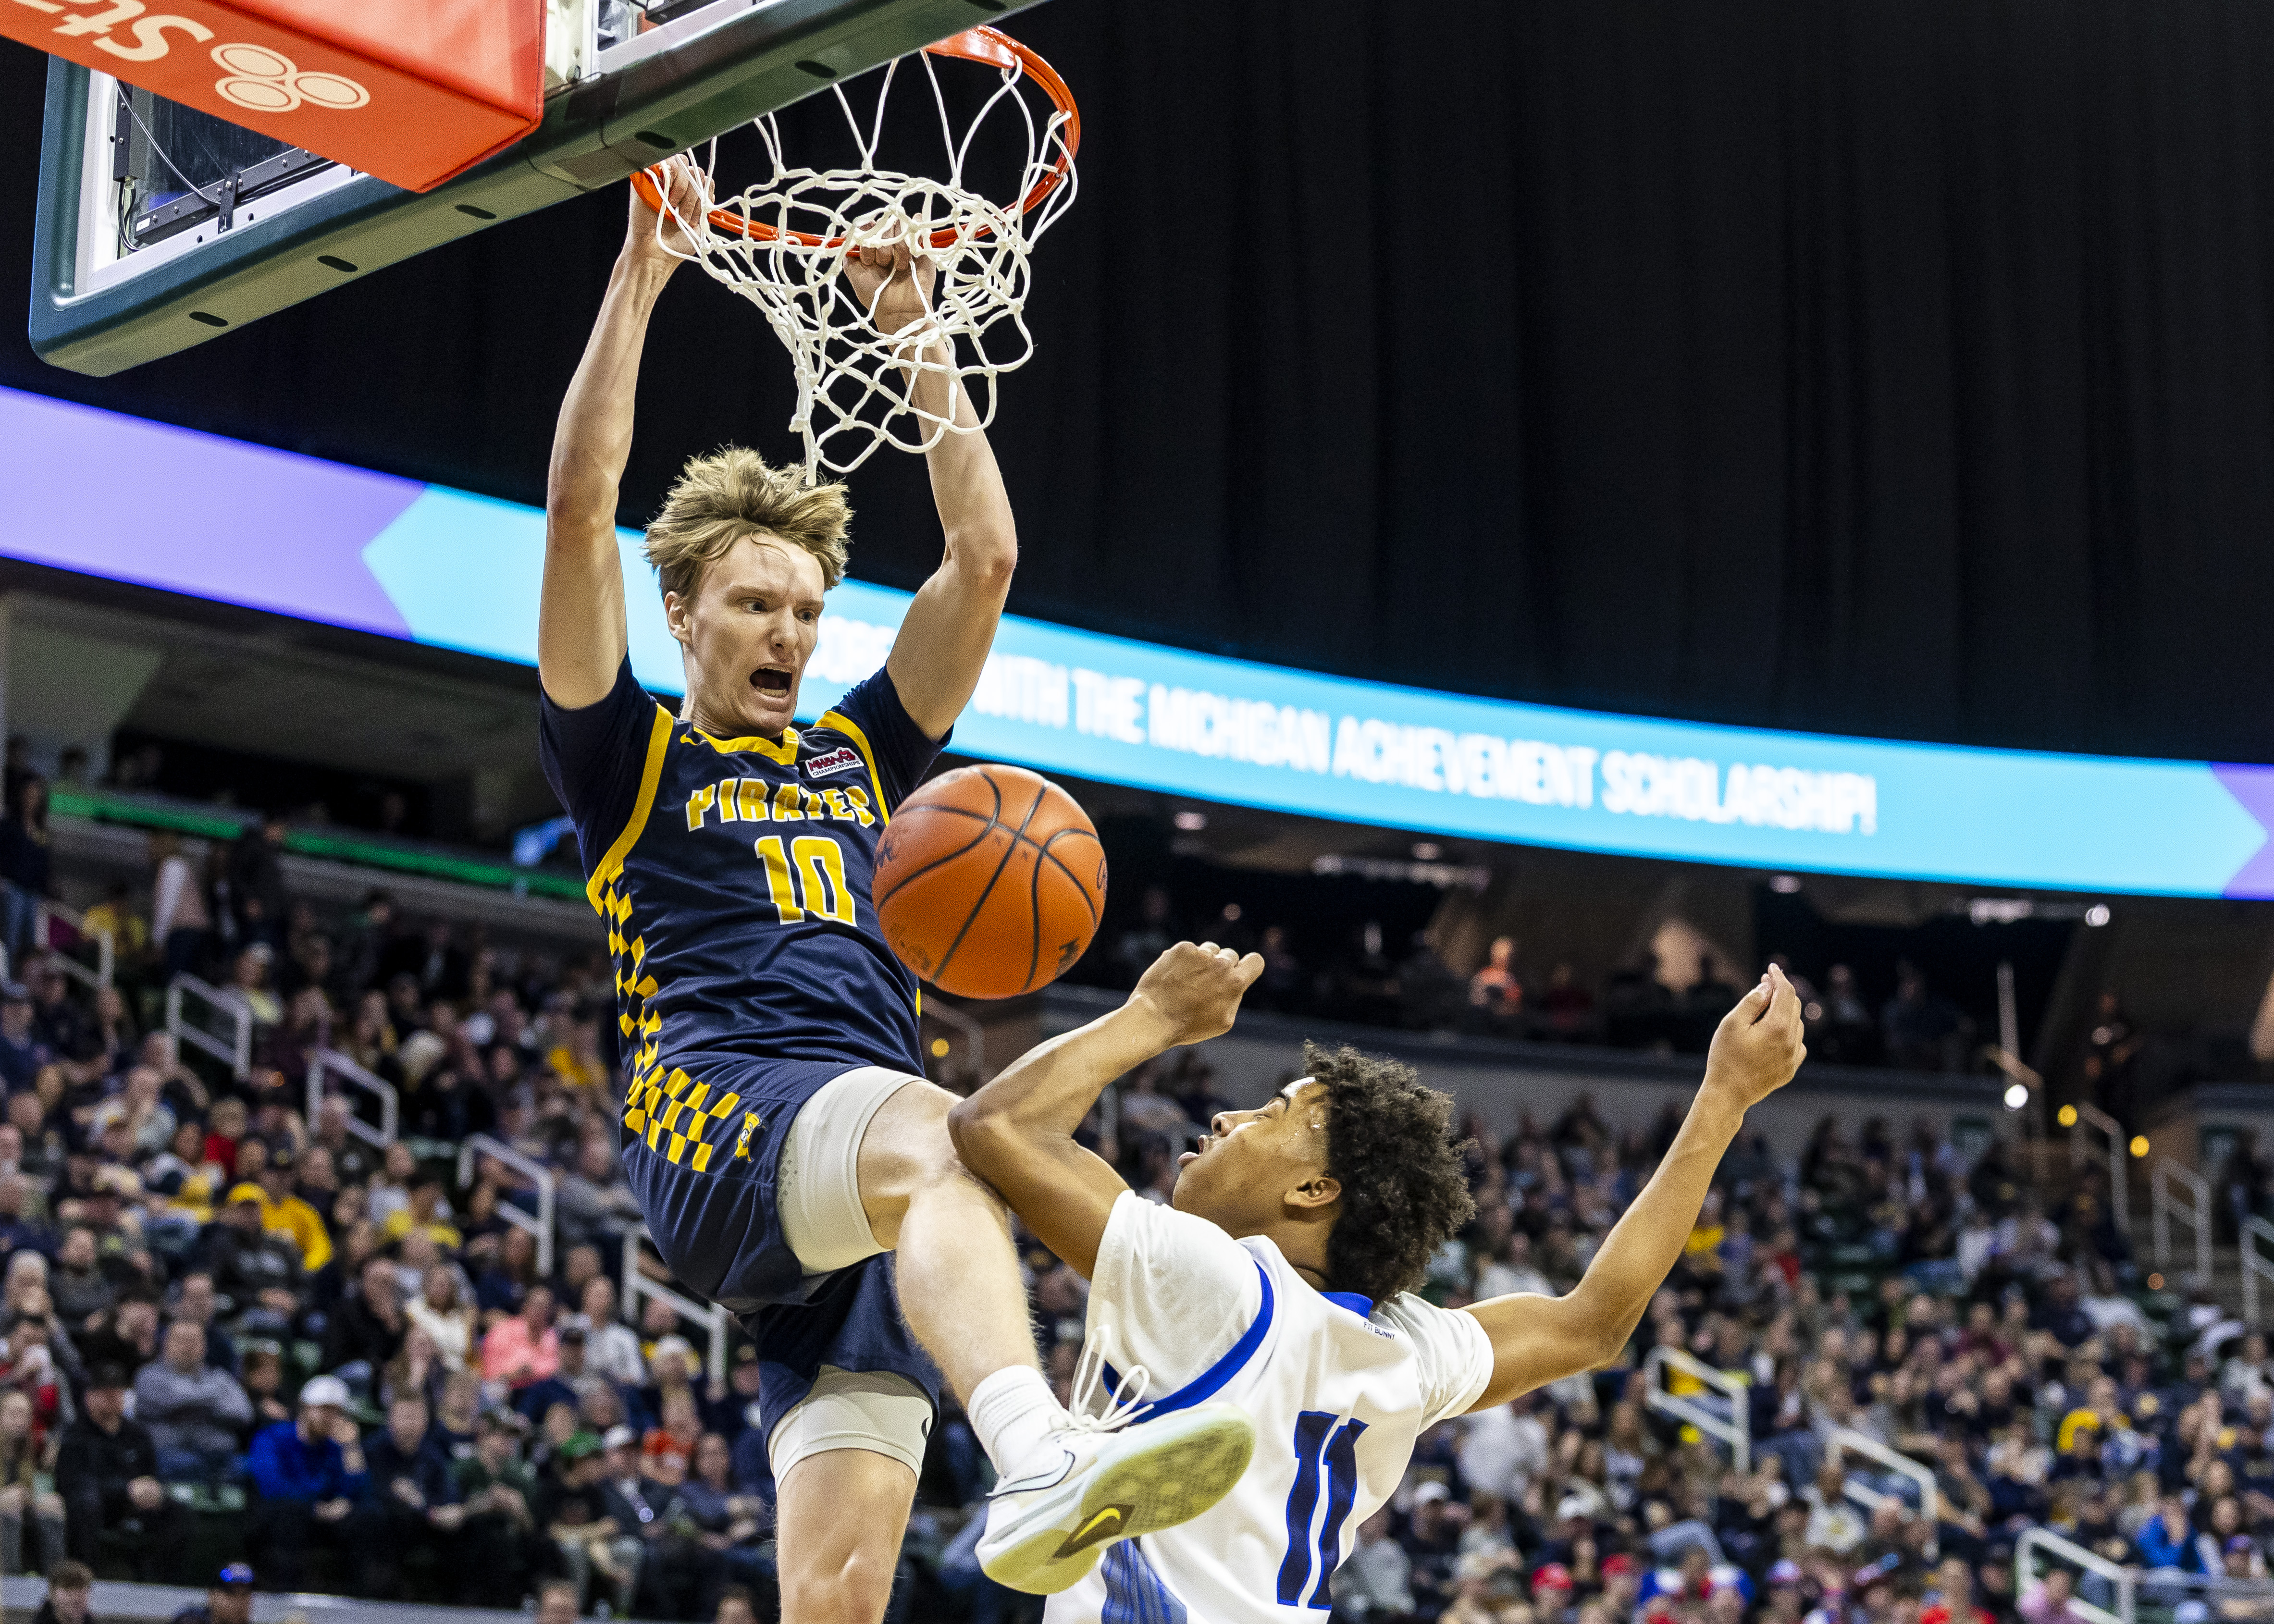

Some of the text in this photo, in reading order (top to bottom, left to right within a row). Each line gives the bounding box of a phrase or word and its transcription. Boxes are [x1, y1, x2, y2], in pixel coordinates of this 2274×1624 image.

[973, 650, 1069, 729] WITH
[1070, 667, 1146, 745] THE
[1149, 682, 1331, 776] MICHIGAN
[1333, 714, 1599, 811] ACHIEVEMENT
[813, 761, 860, 776] CHAMPIONSHIPS
[686, 778, 876, 832] PIRATES
[754, 836, 858, 927] 10
[1374, 1326, 1395, 1341] BUNNY
[1276, 1410, 1370, 1611] 11
